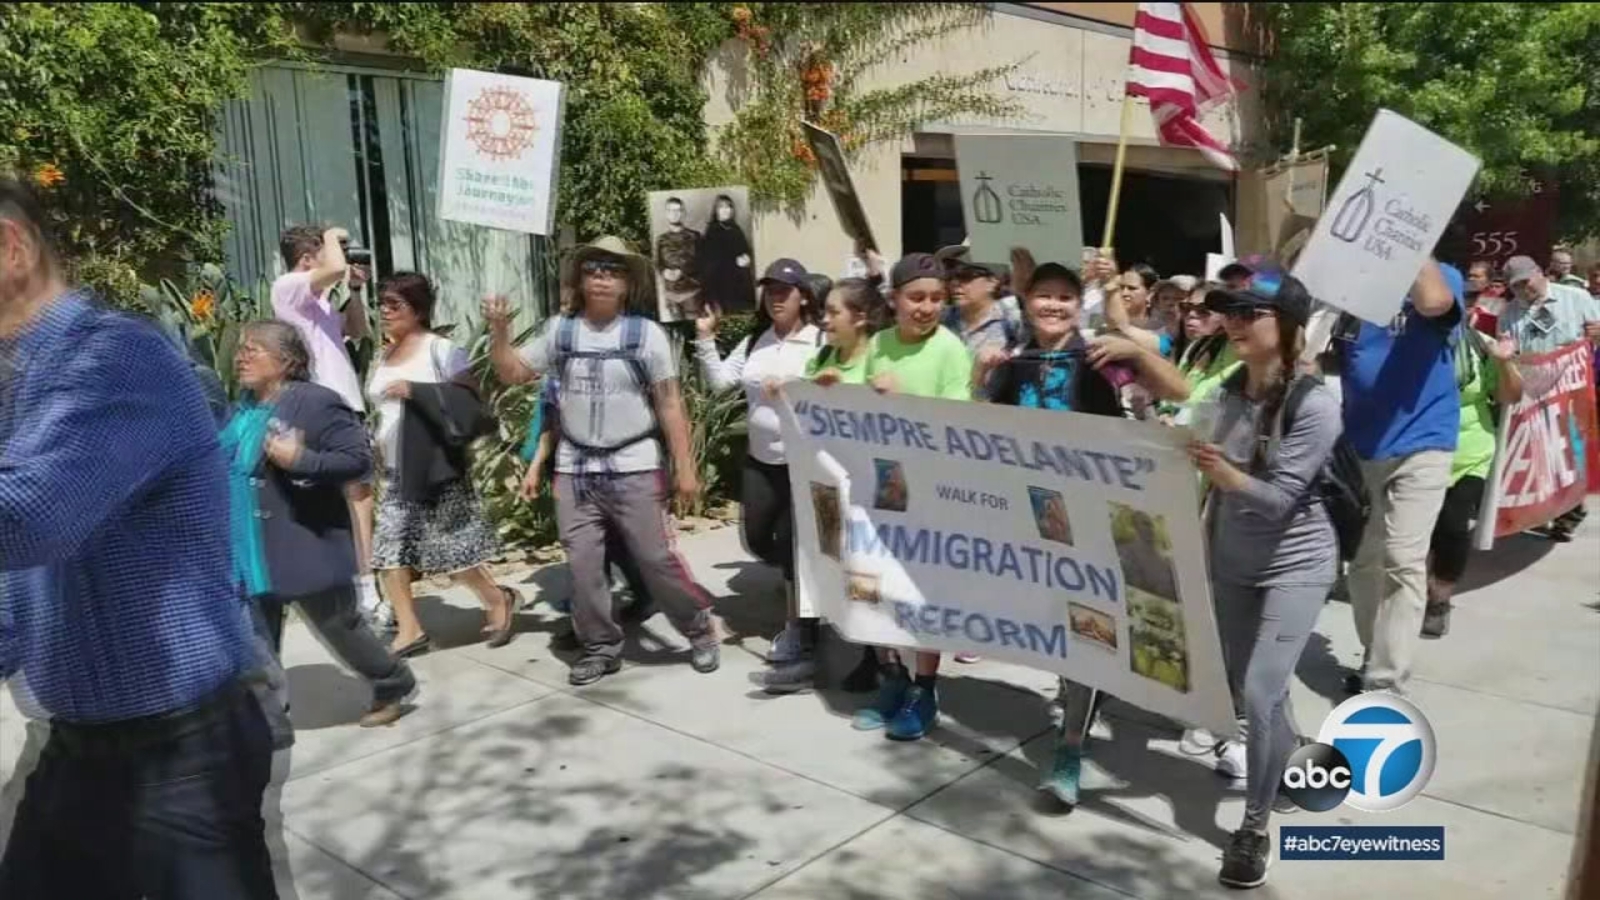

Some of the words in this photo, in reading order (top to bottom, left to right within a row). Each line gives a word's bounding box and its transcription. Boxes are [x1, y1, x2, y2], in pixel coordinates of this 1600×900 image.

[1363, 235, 1392, 261] USA
[1472, 231, 1519, 256] 555
[936, 483, 978, 505] WALK
[980, 491, 1009, 511] FOR
[846, 519, 1118, 603] IMMIGRATION
[895, 601, 1068, 659] REFORM
